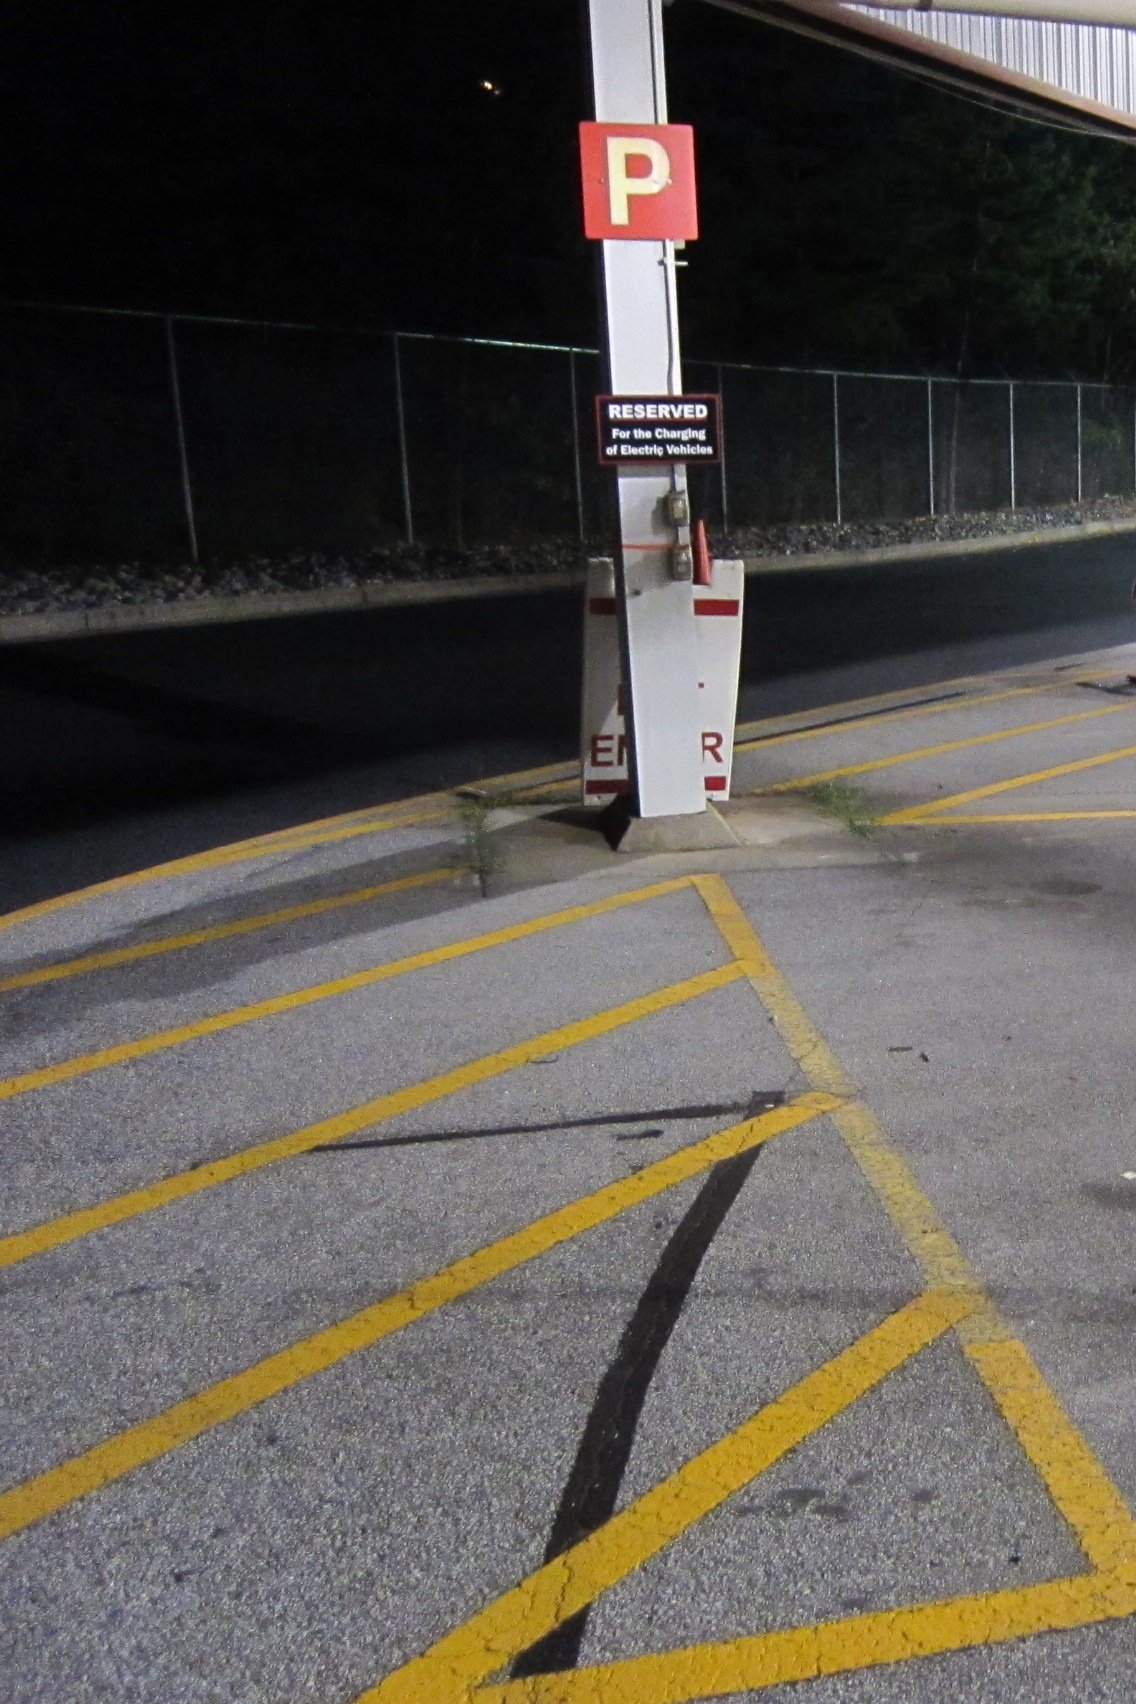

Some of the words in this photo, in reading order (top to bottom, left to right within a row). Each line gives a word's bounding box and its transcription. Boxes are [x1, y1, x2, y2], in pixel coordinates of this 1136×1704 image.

[606, 136, 671, 226] P
[608, 404, 708, 419] RESERVED
[612, 428, 631, 439] For
[633, 428, 652, 439] the
[654, 428, 707, 441] Charging
[606, 444, 618, 455] of
[620, 444, 664, 456] Electric
[666, 444, 713, 455] Vehicles
